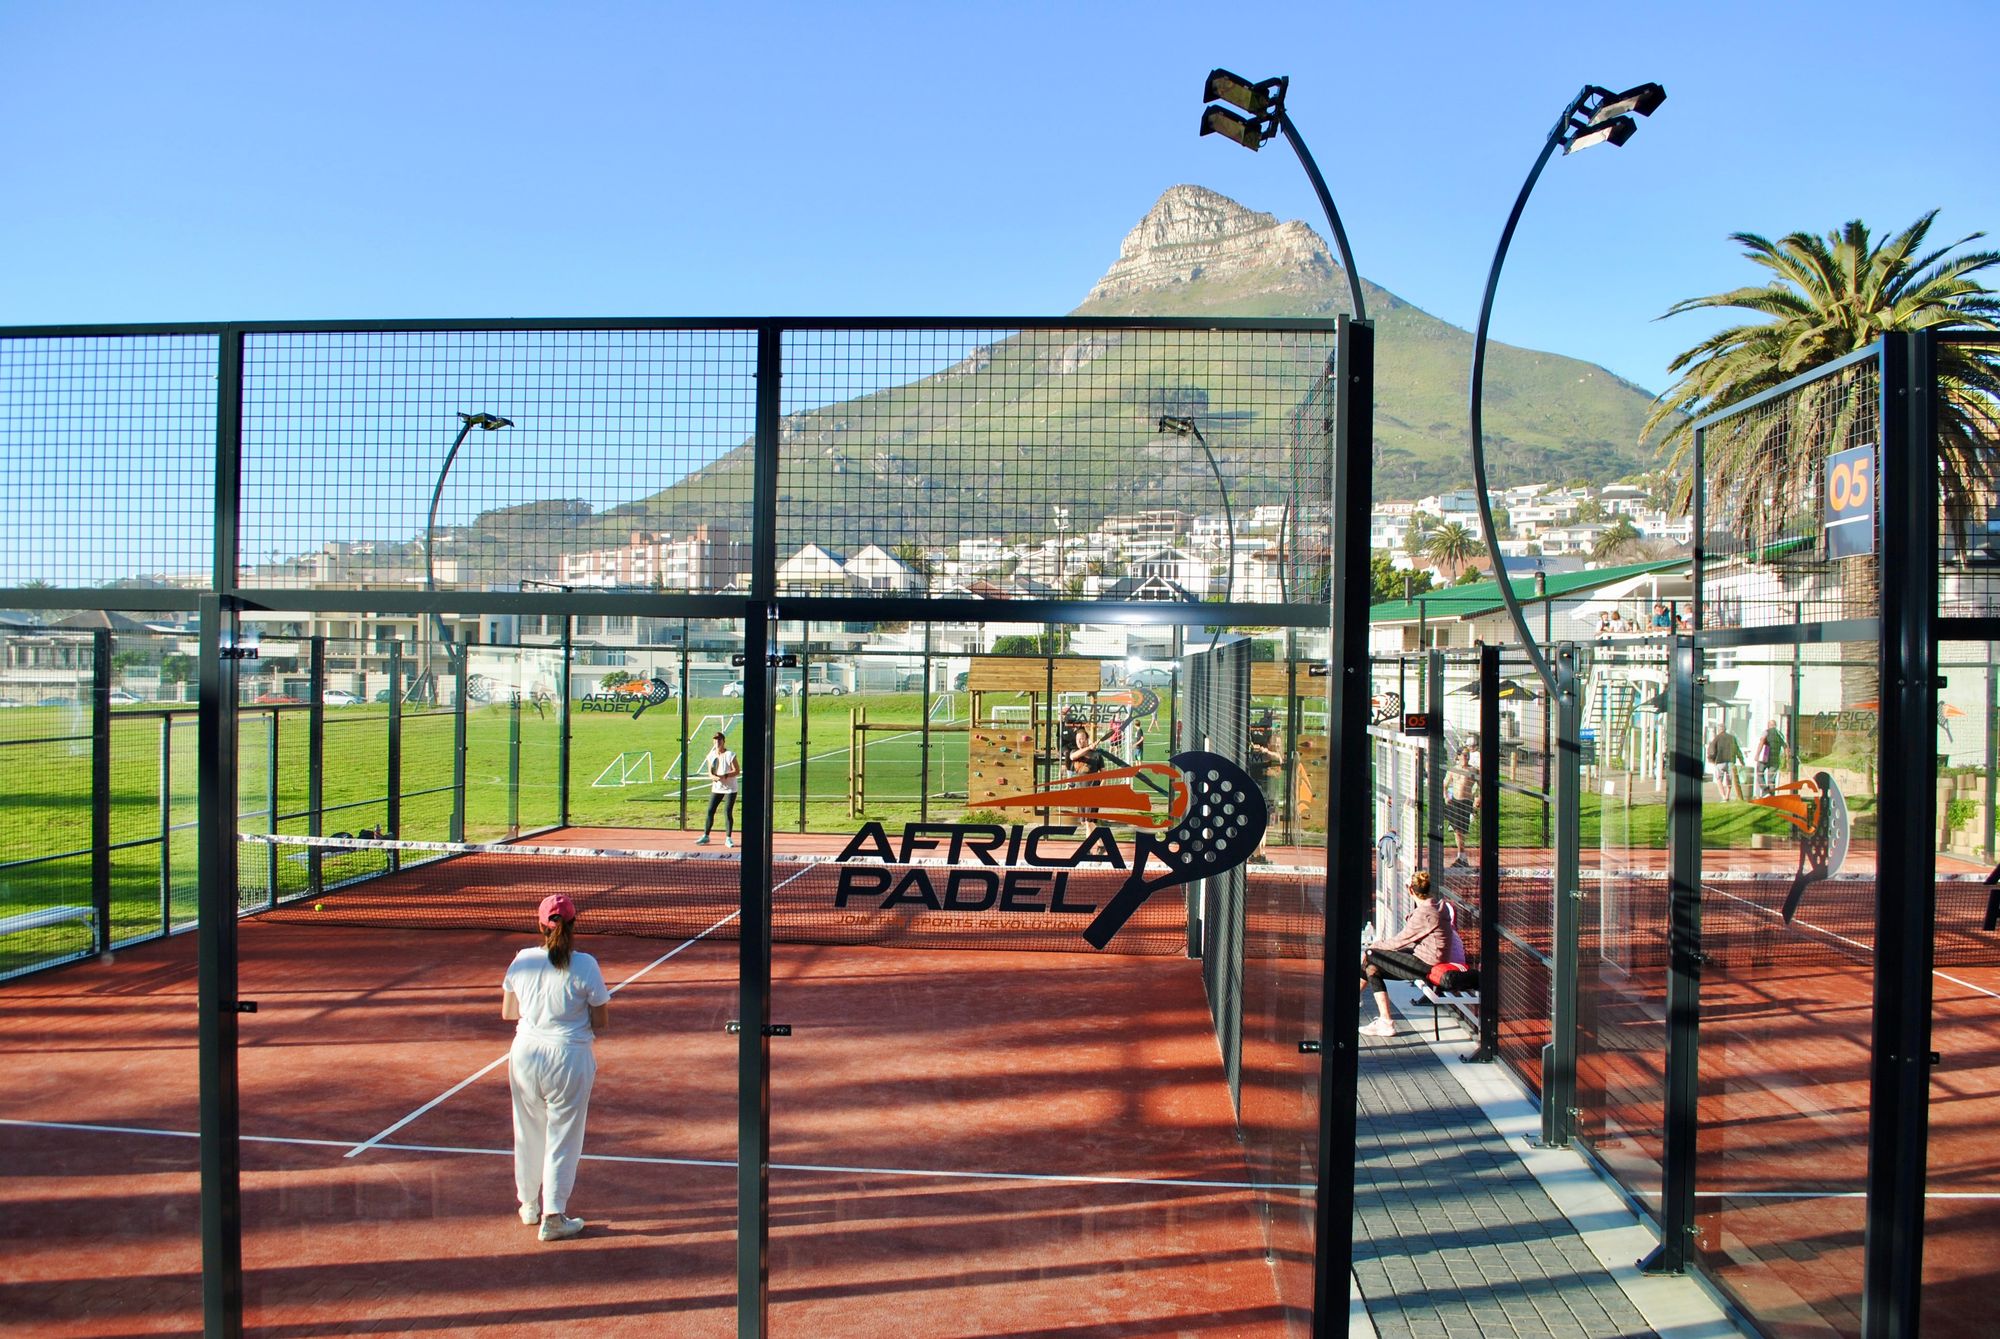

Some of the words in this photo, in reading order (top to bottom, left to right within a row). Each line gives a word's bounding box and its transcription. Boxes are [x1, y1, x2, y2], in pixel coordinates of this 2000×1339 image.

[1829, 458, 1869, 512] 05
[581, 703, 635, 713] PADEL
[1408, 716, 1426, 727] 05
[1814, 711, 1878, 721] AFRICA
[834, 866, 1098, 914] PADEL
[837, 915, 872, 925] JOIN
[911, 917, 974, 929] SPORTS
[979, 919, 1081, 930] REVOLUTION
